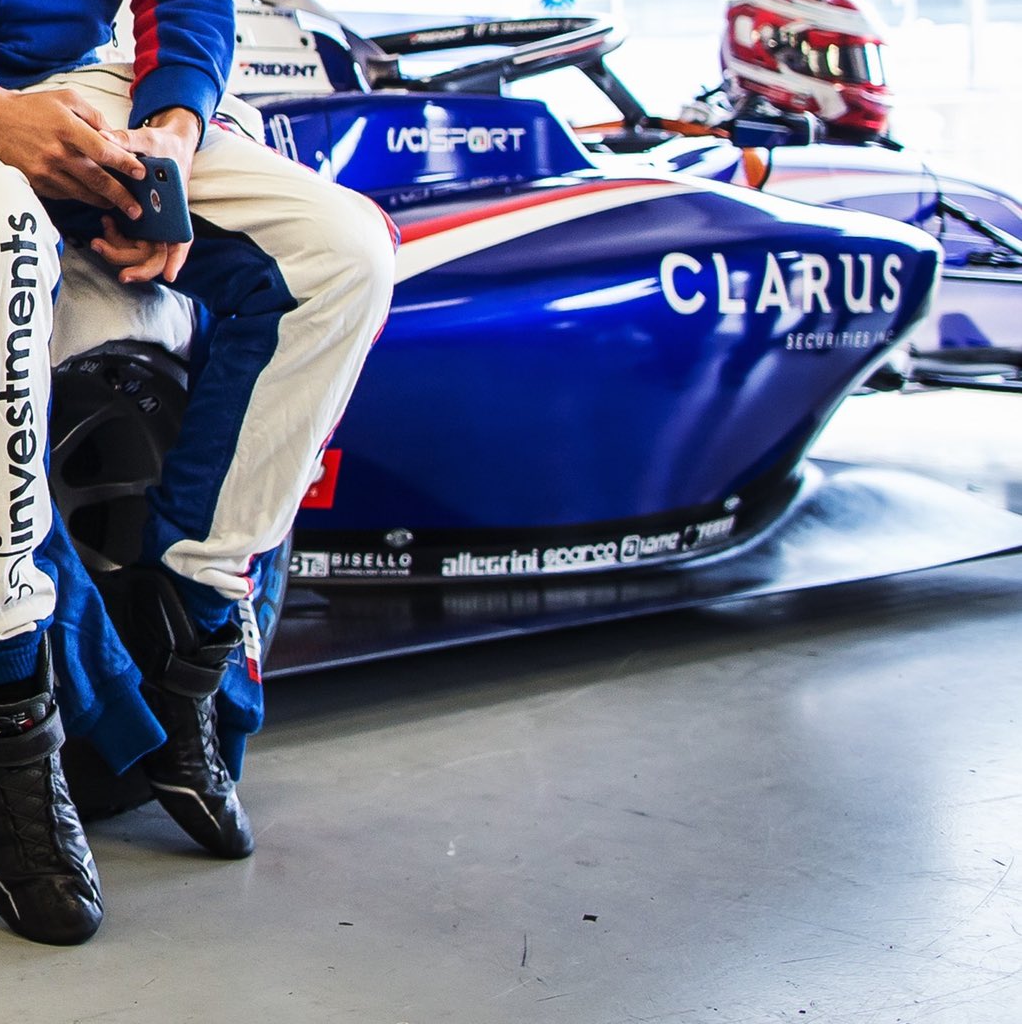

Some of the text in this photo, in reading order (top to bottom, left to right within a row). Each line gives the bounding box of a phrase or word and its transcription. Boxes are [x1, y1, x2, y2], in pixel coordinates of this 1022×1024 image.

[239, 63, 318, 77] TRIDENT
[660, 251, 902, 315] CLARUS
[331, 553, 412, 567] BISELLO
[442, 549, 538, 576] allegrini
